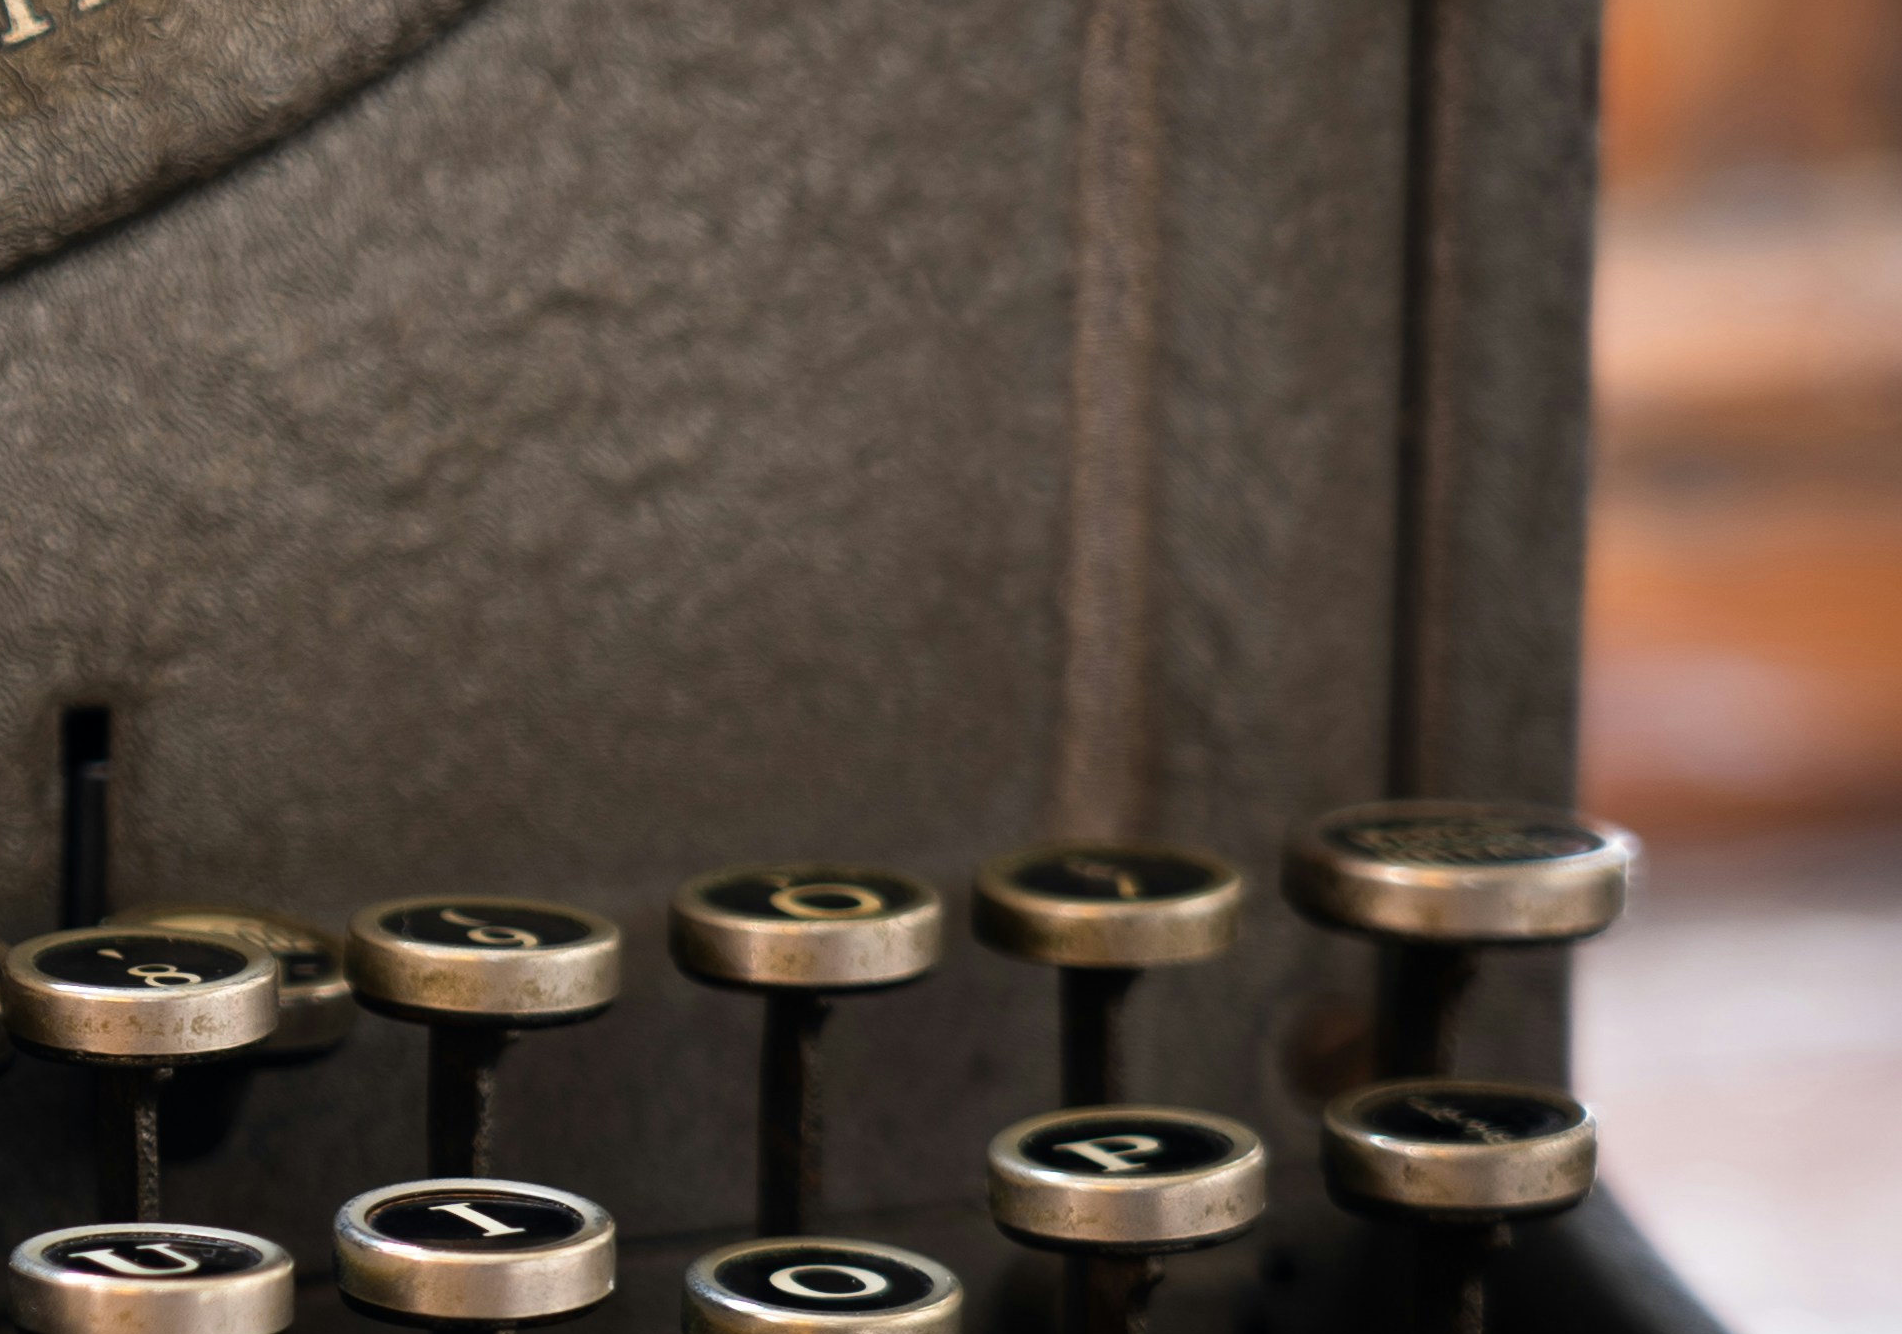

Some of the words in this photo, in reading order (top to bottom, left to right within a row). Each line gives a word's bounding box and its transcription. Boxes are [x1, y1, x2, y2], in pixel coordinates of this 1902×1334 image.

[127, 963, 203, 987] 8
[1052, 1136, 1162, 1173] P
[428, 1203, 526, 1238] I
[66, 1243, 200, 1276] U
[768, 1265, 890, 1300] O
